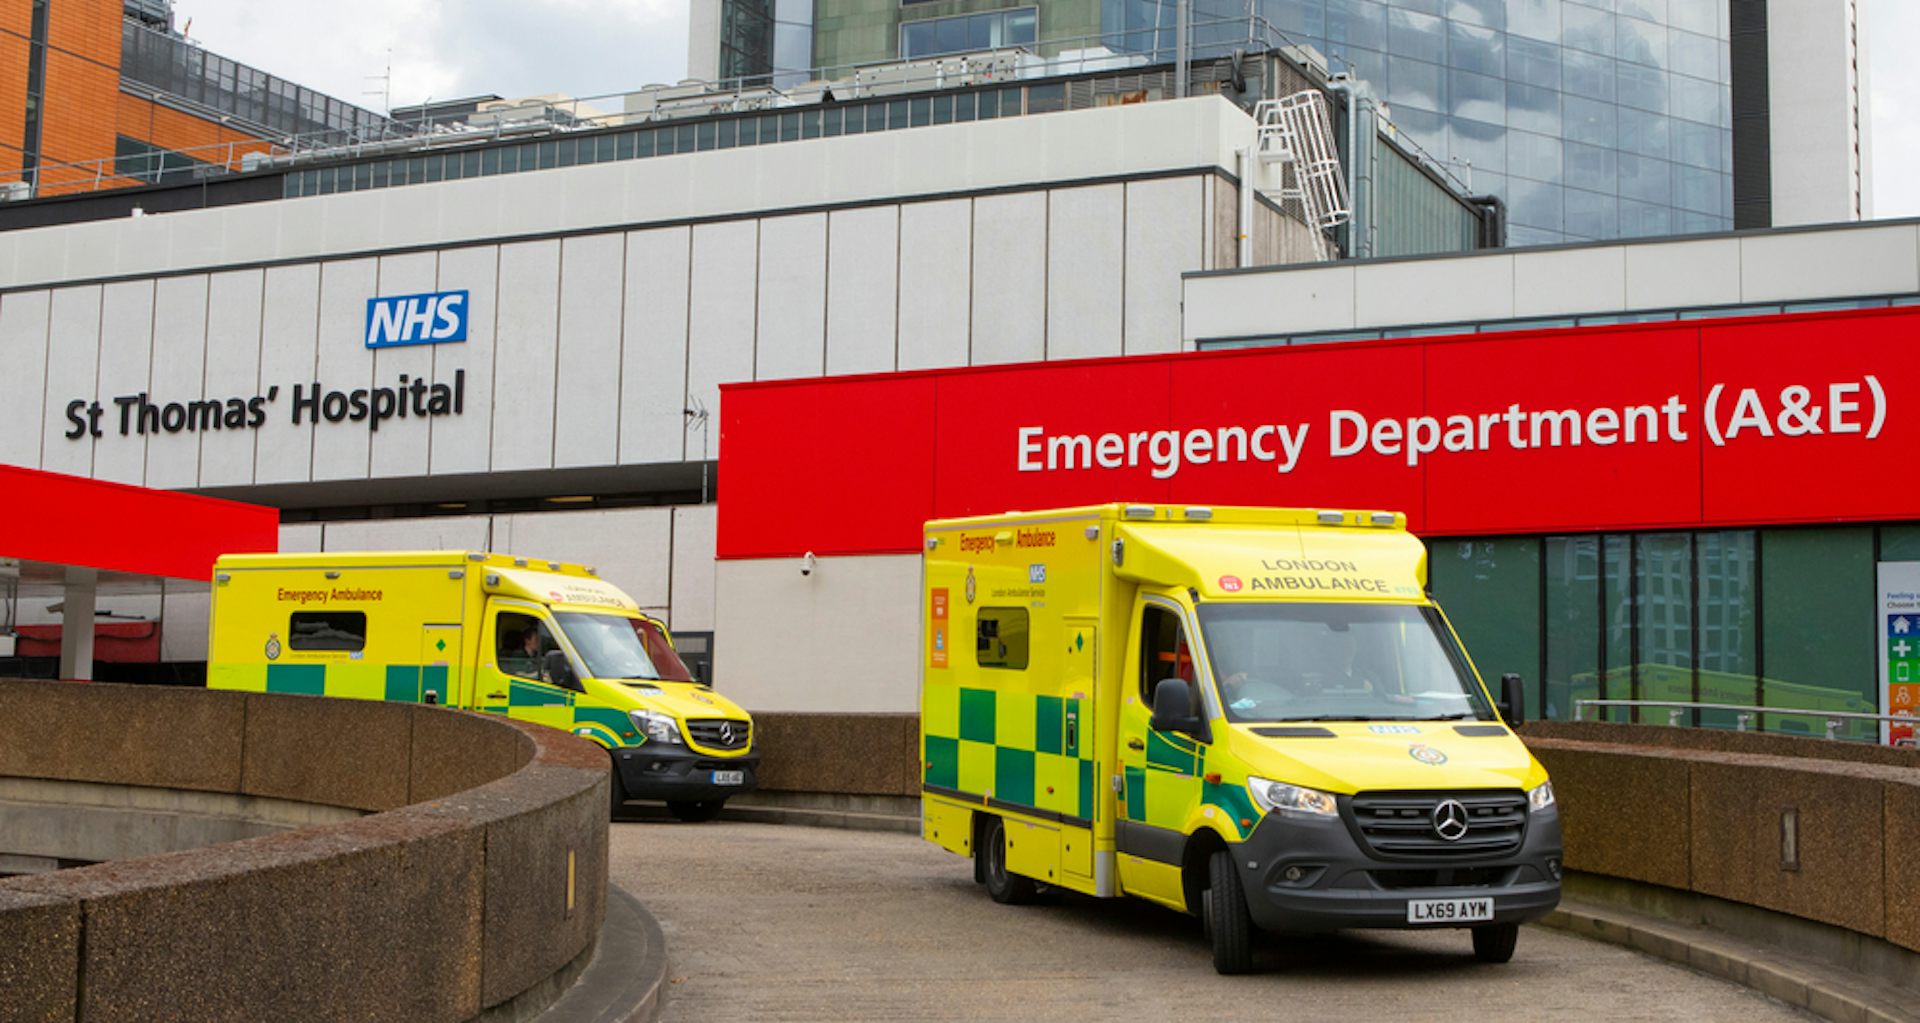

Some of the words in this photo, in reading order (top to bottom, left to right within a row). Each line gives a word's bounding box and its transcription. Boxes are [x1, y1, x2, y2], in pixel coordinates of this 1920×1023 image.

[367, 294, 463, 346] NHS
[64, 399, 104, 441] St
[290, 368, 466, 433] Hospital
[1017, 422, 1311, 480] Emergency
[1329, 394, 1689, 468] Department
[1703, 374, 1888, 447] (A&E)
[961, 533, 996, 555] Emergency
[1017, 528, 1056, 548] Ambulance
[1030, 564, 1045, 582] NHS
[1261, 559, 1359, 573] LONDON
[1251, 576, 1392, 594] AMBULANCE
[277, 588, 329, 604] Emergency
[330, 588, 384, 601] Ambulance
[1887, 592, 1914, 600] Feeling
[1368, 725, 1422, 734] NHS
[1415, 902, 1455, 919] LX69
[1460, 901, 1487, 917] AYM
